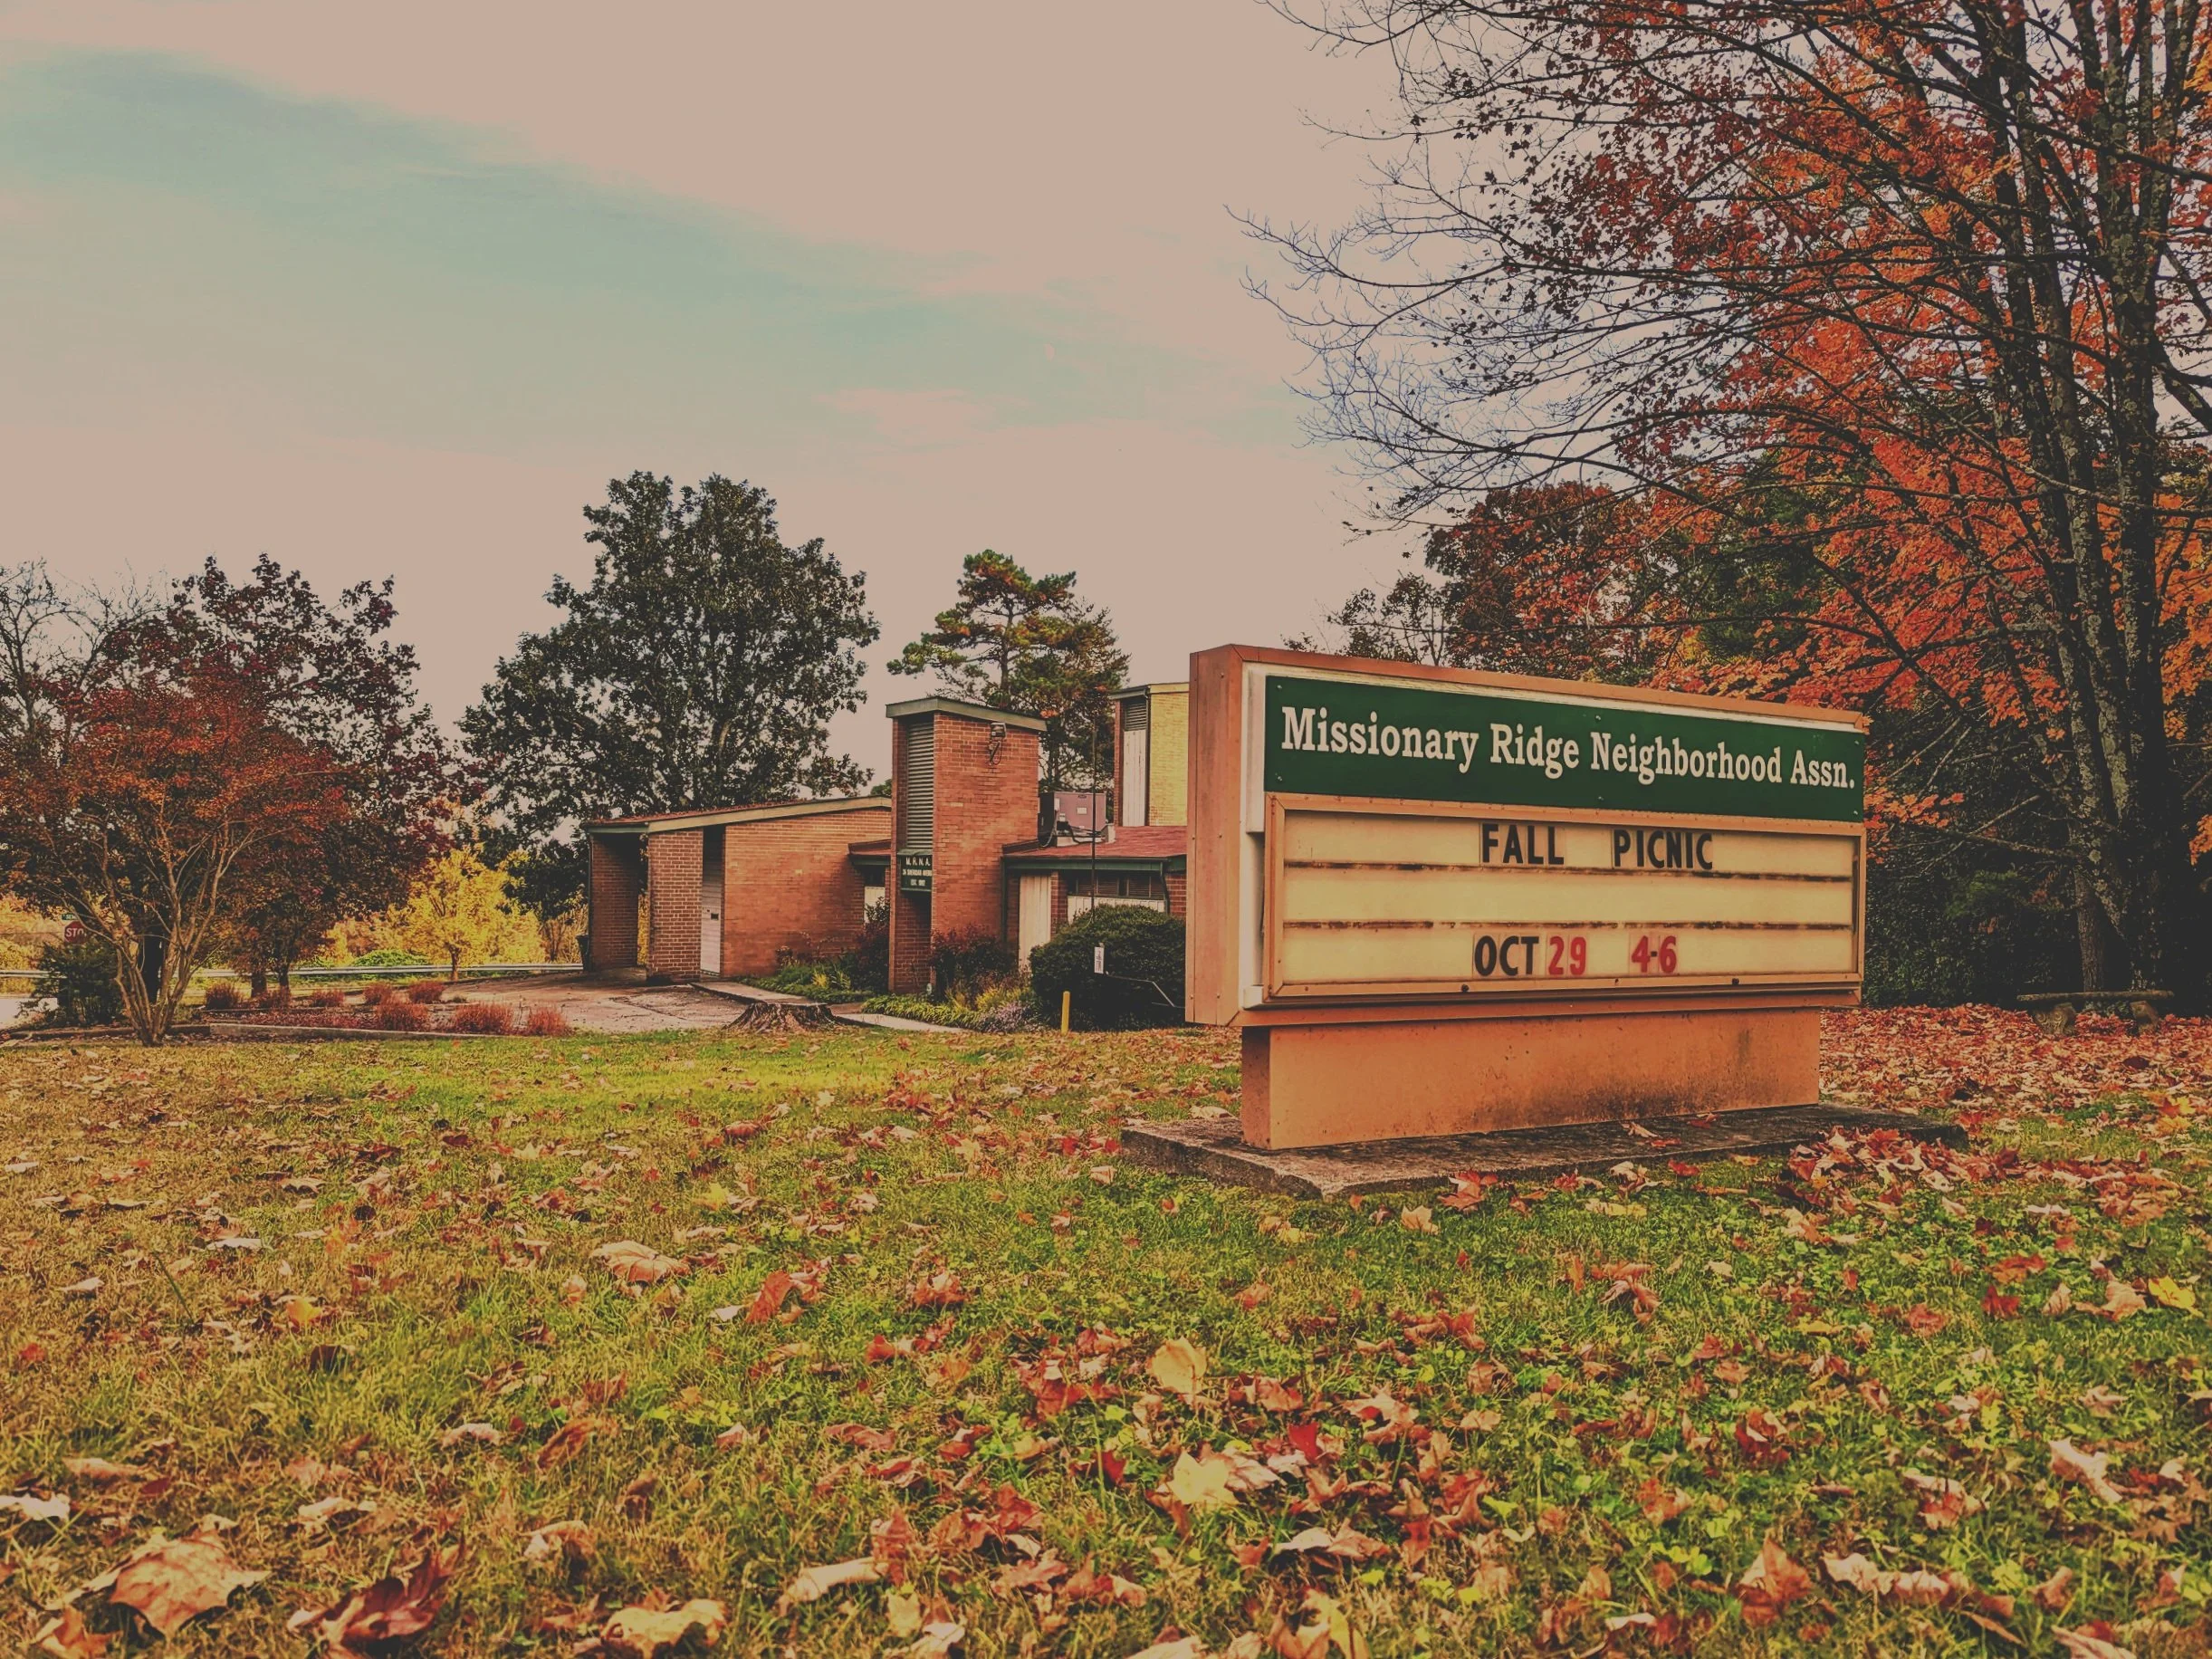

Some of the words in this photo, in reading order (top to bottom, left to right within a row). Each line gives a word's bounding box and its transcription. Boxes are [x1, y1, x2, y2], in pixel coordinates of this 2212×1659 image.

[1281, 706, 1479, 773] Missionary
[1489, 723, 1580, 780] Ridge
[1590, 731, 1783, 785] Neighborhood
[1790, 750, 1855, 789] Assn.
[1482, 822, 1565, 866] FALL
[1614, 828, 1713, 871] PICNIC
[65, 927, 86, 937] STO
[1474, 935, 1539, 977] OCT
[1547, 935, 1587, 976] 29
[1631, 935, 1678, 974] 4-6
